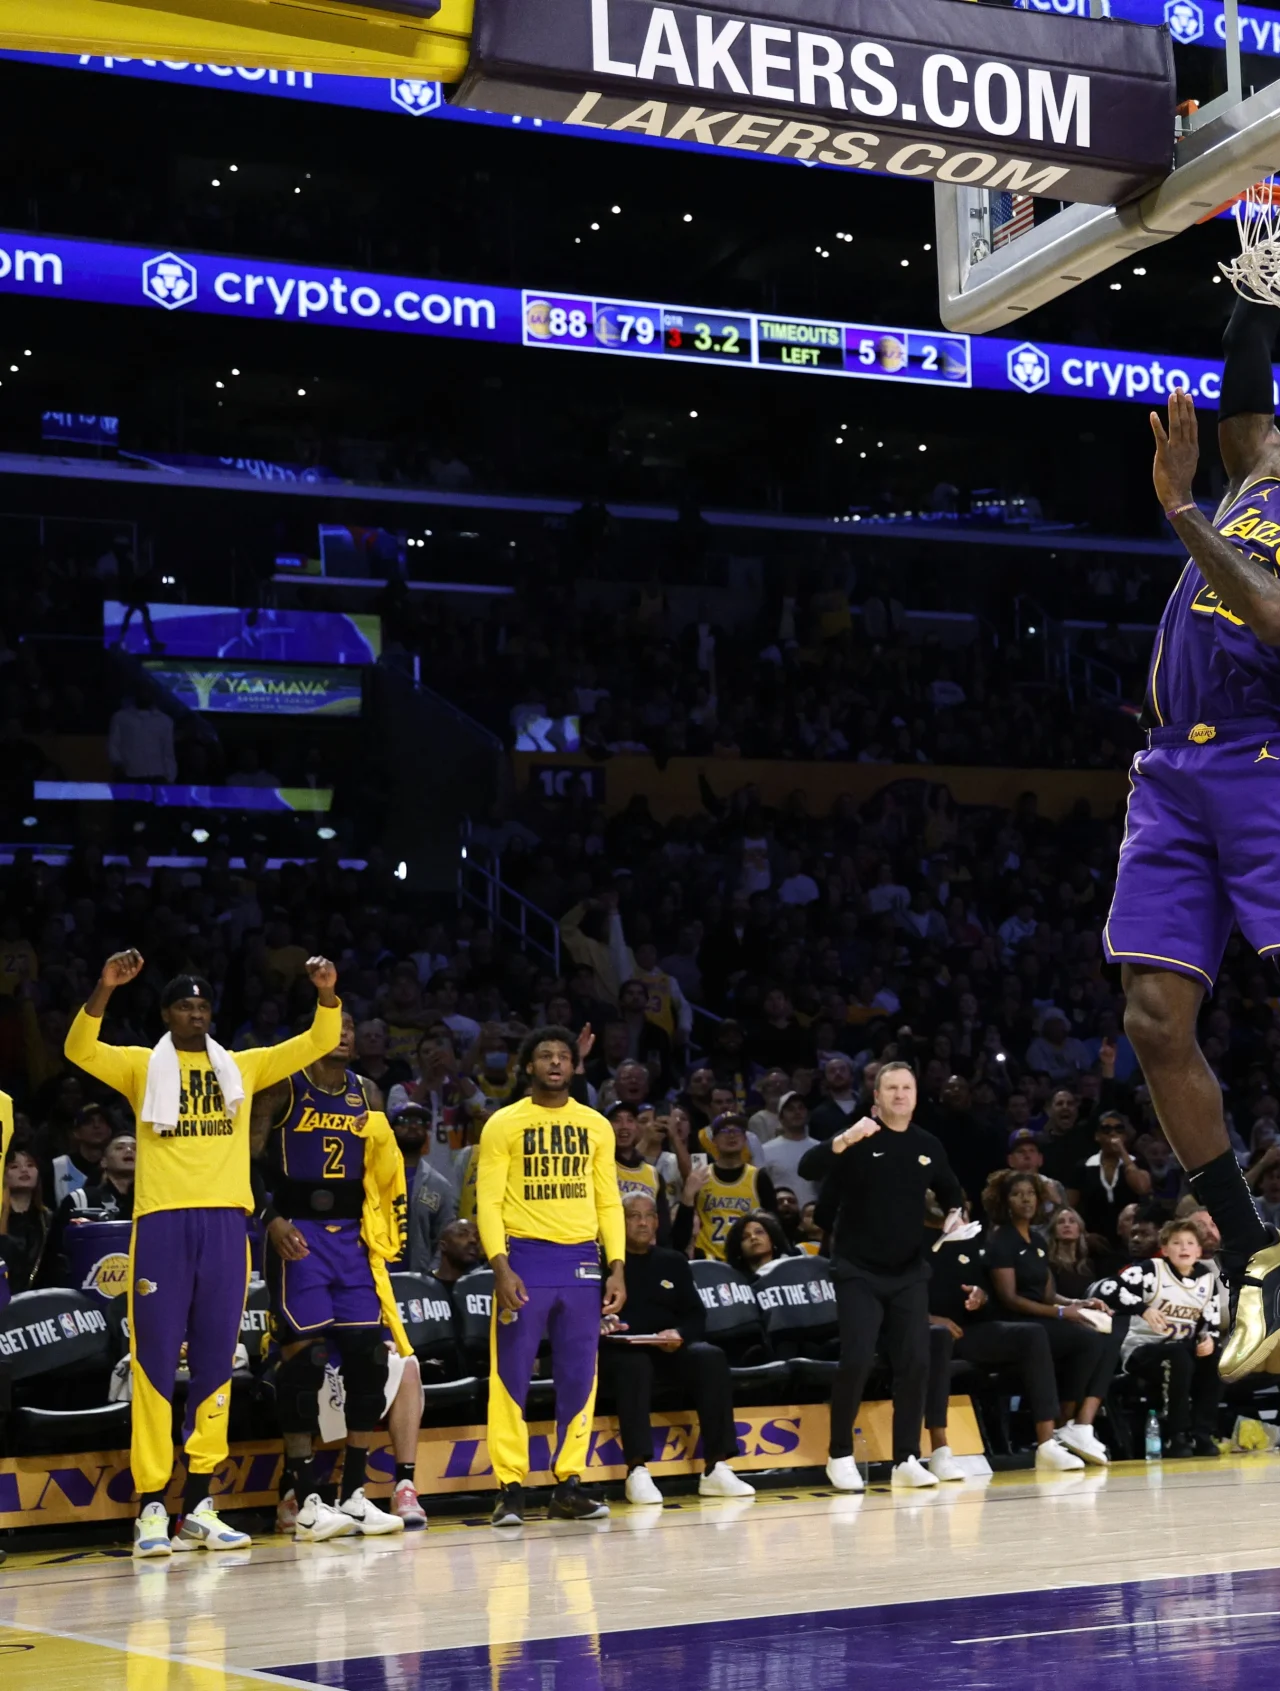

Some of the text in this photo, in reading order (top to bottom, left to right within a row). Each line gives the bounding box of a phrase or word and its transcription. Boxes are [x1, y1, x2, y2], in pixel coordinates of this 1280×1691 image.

[592, 0, 1090, 149] LAKERS.COM
[562, 91, 1071, 194] LAKERS.COM
[214, 272, 496, 329] crypto.com
[549, 307, 587, 339] 88
[617, 314, 655, 346] 79
[760, 321, 839, 347] TIMEOUTS
[668, 327, 682, 349] 3
[694, 322, 740, 353] 3.2
[781, 347, 821, 367] LEFT
[858, 340, 876, 365] 5
[921, 346, 938, 370] 2
[1061, 357, 1279, 405] crypto.c
[200, 1118, 233, 1136] VOICES
[293, 1107, 356, 1133] LAKER
[523, 1125, 590, 1155] BLACK
[323, 1136, 345, 1178] 2
[523, 1156, 589, 1177] HISTORY
[524, 1182, 587, 1200] BLACK VOICES
[422, 1297, 452, 1322] App
[466, 1293, 492, 1317] GET
[698, 1286, 719, 1309] HE
[756, 1286, 784, 1310] GET
[781, 1284, 809, 1306] THE
[1159, 1299, 1201, 1319] LAKER
[0, 1331, 28, 1356] GET
[25, 1318, 61, 1346] THE
[74, 1308, 107, 1334] App
